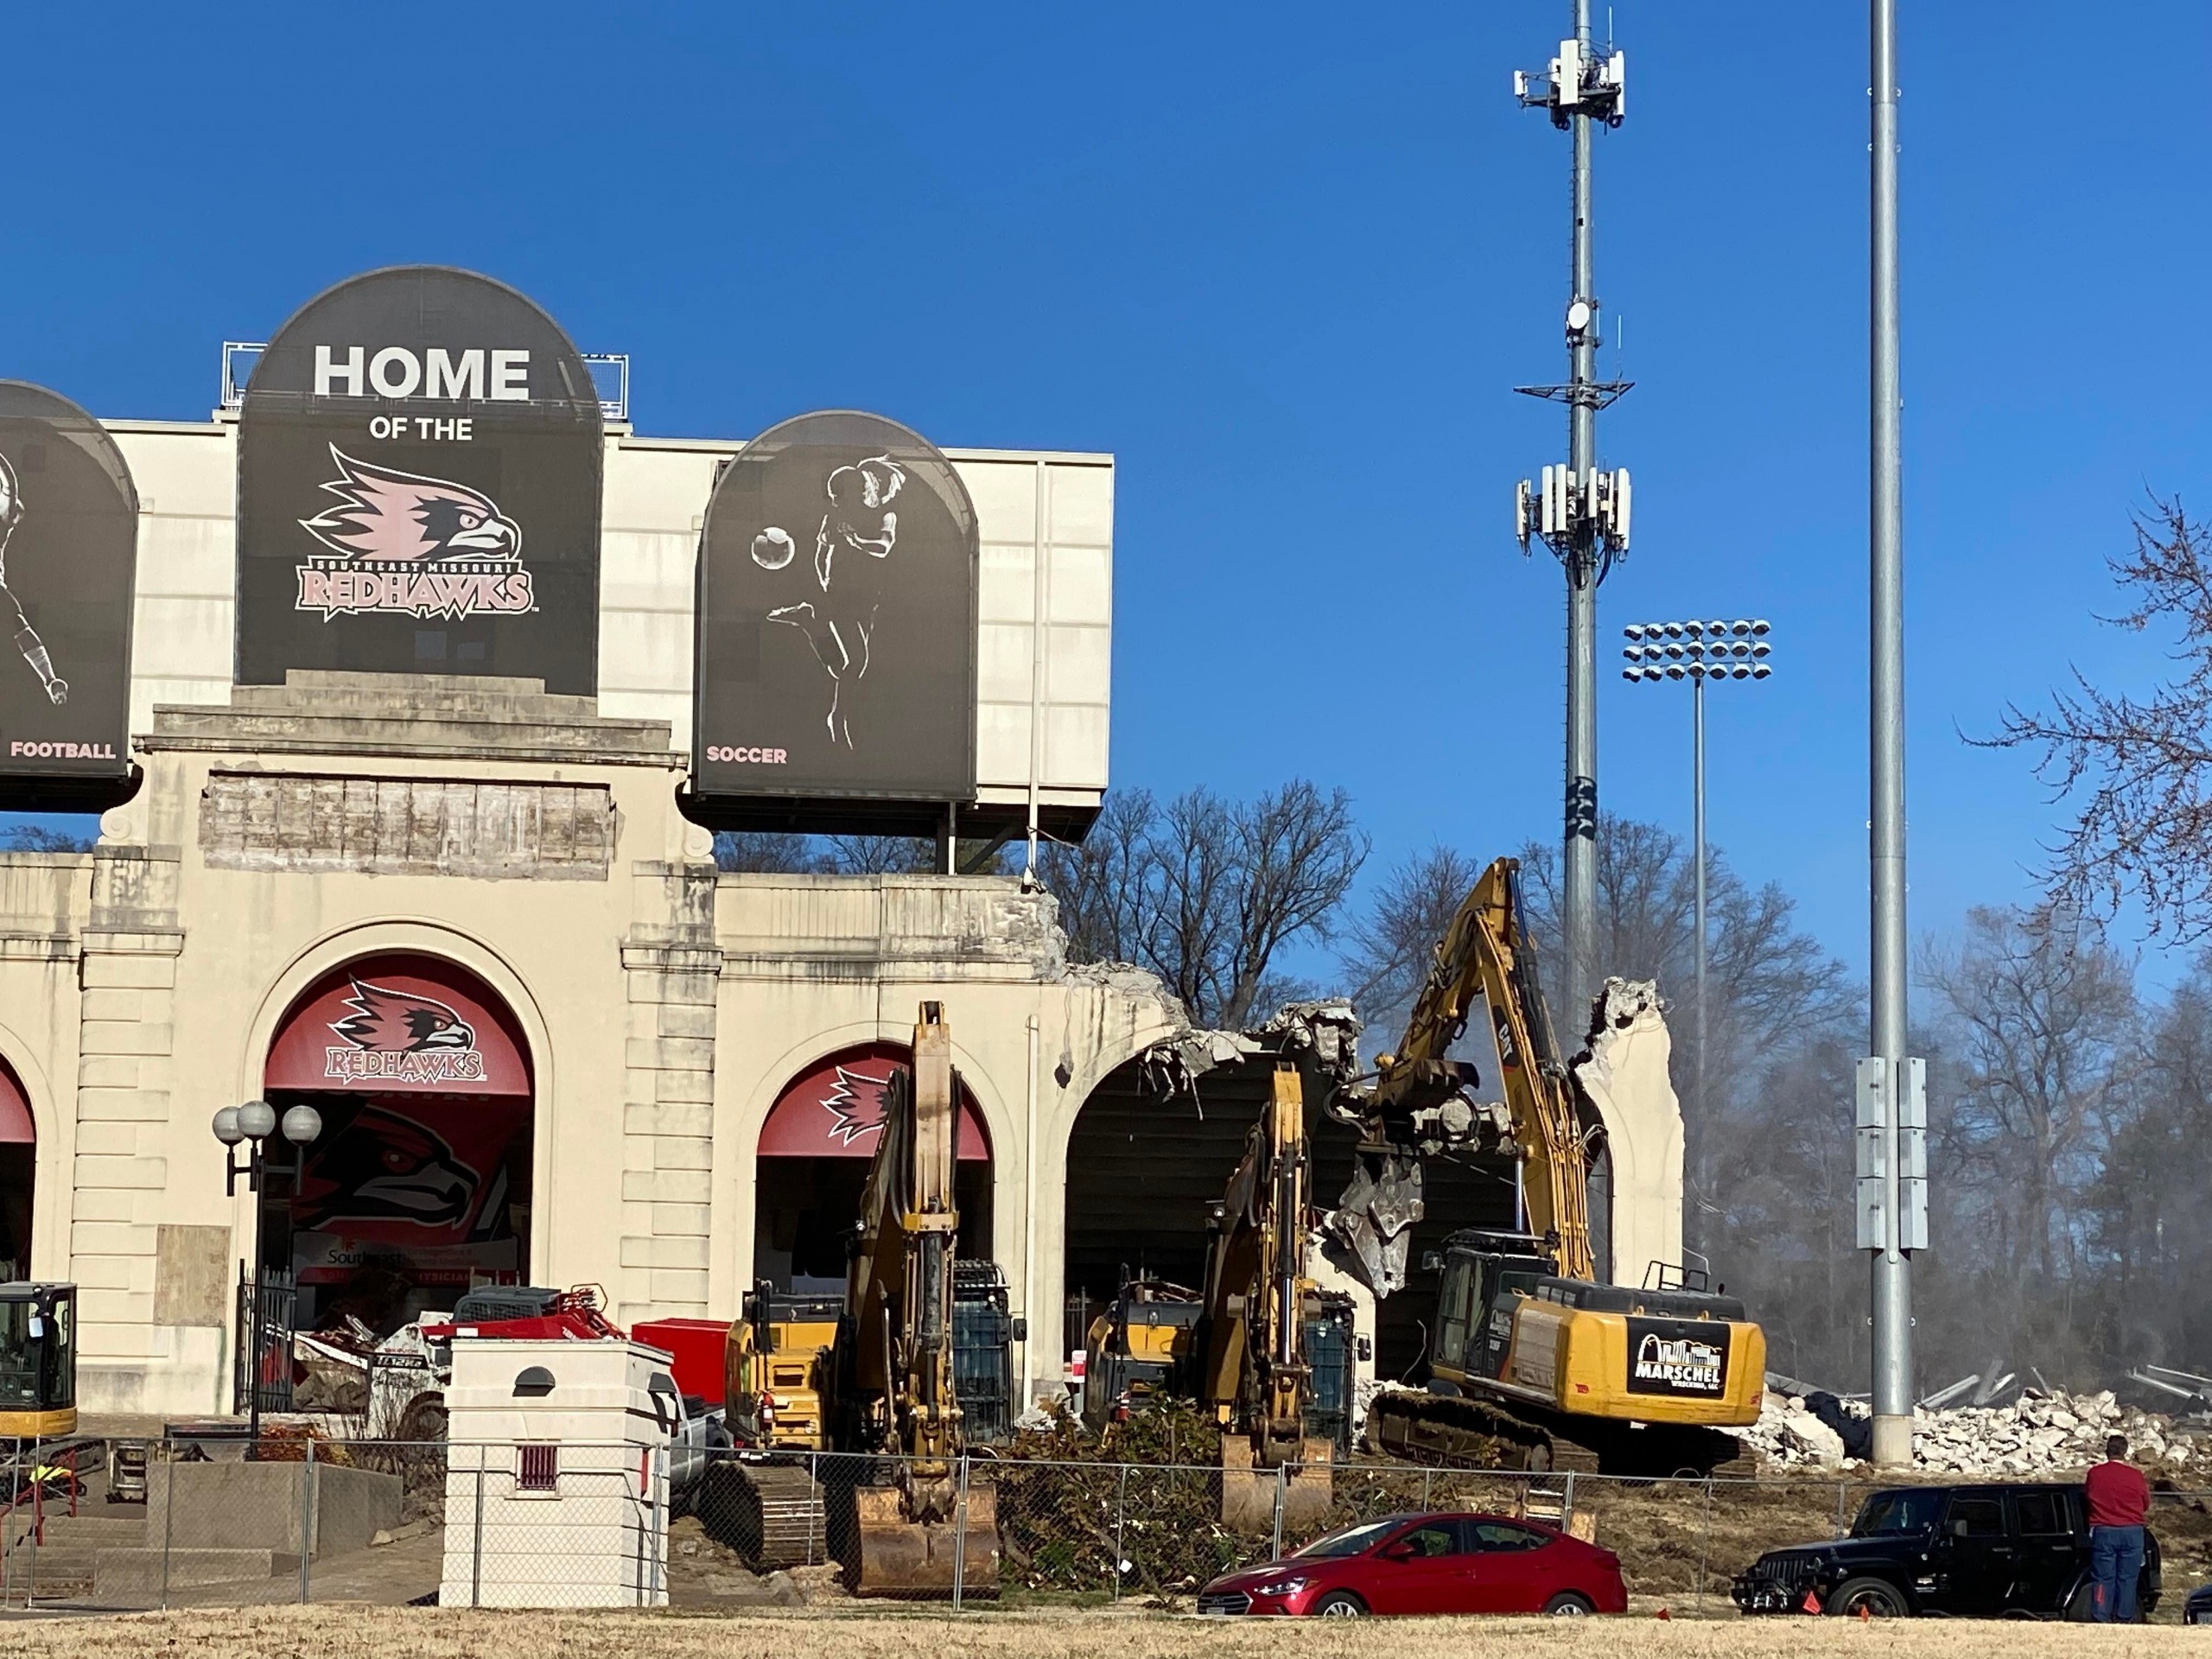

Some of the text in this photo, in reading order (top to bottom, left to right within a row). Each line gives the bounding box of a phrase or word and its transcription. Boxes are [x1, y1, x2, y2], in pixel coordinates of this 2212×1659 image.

[315, 346, 530, 400] HOME
[369, 416, 473, 441] OF THE
[316, 560, 512, 574] SOUTHEAST MISSOURI
[302, 569, 532, 613] REDHAWKS
[10, 741, 117, 760] FOOTBALL
[706, 745, 788, 765] SOCCER
[1498, 1023, 1514, 1060] CAT
[326, 1049, 484, 1080] REDHAWKS
[1635, 1362, 1720, 1383] MARSCHEL
